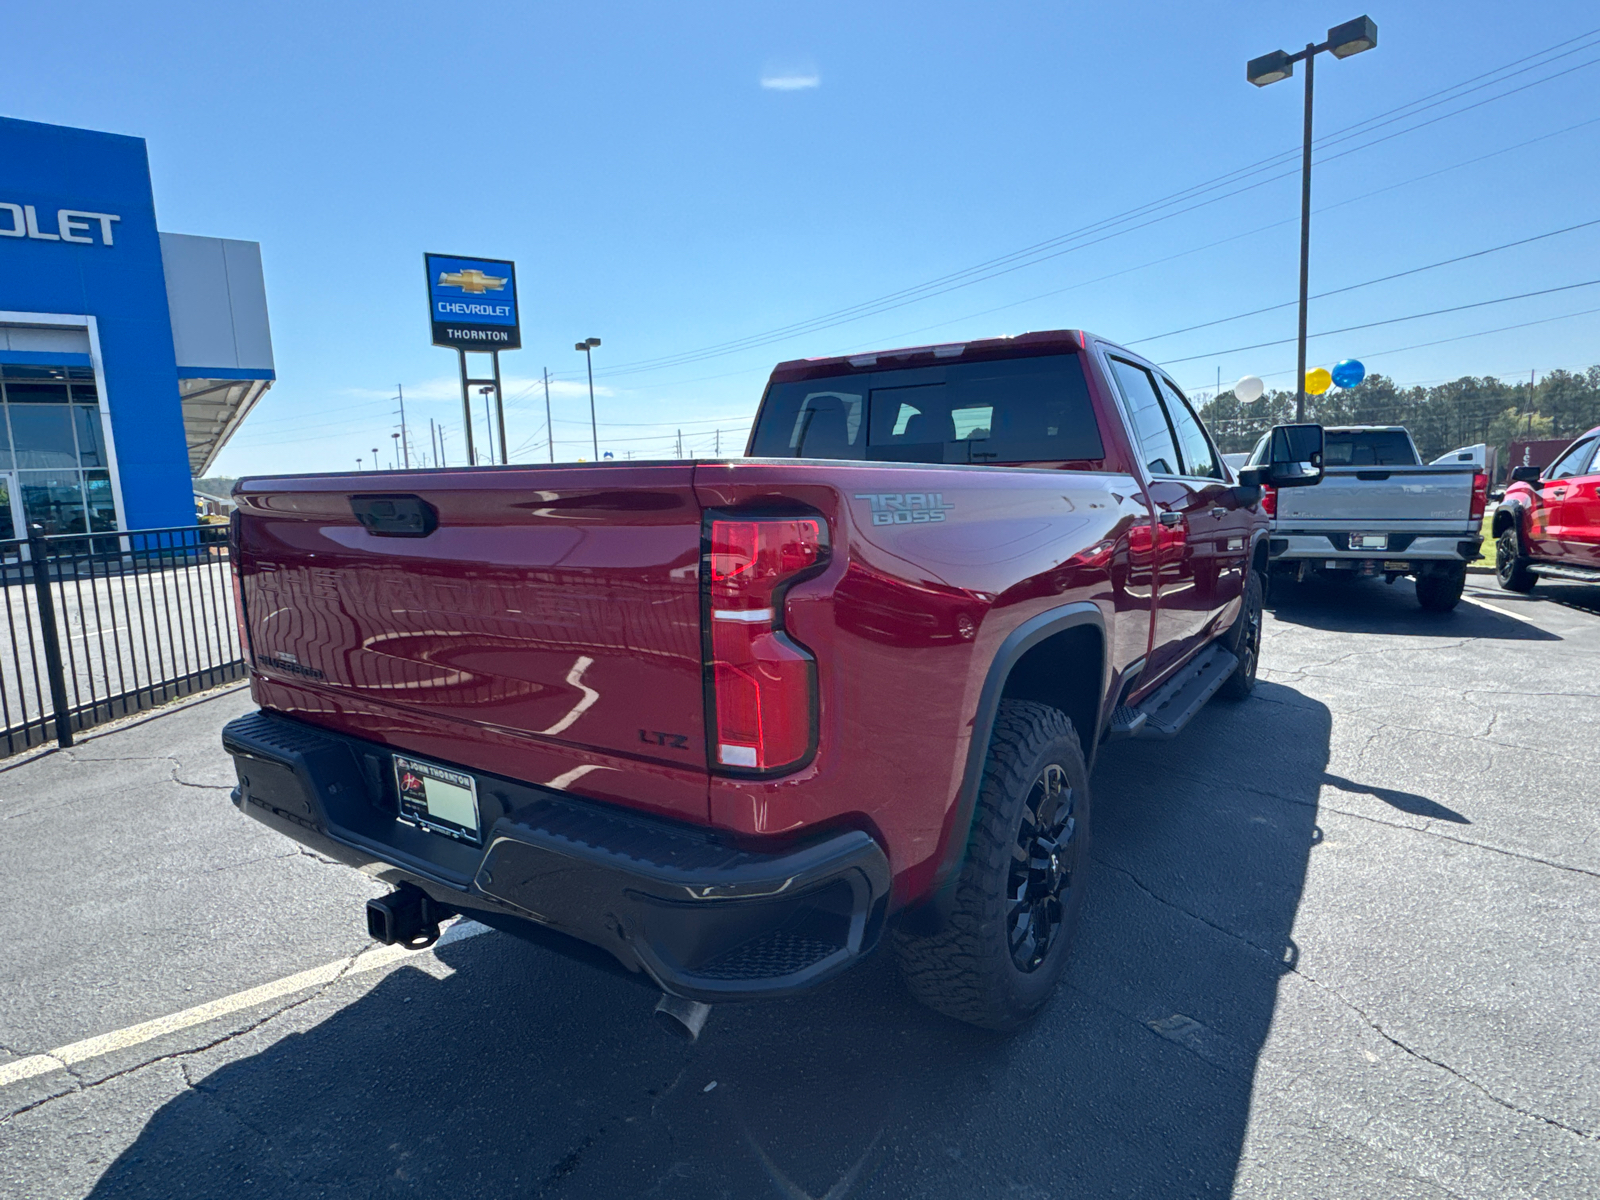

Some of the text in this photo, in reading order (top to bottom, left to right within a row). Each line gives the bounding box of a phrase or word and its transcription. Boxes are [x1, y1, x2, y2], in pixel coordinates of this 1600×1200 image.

[438, 302, 511, 316] CHEVROLET
[447, 329, 508, 341] THORNTON
[854, 493, 955, 512] TRAIL
[872, 509, 946, 526] BOSS
[639, 729, 690, 750] LTZ
[410, 762, 470, 786] JOHN THORNTON
